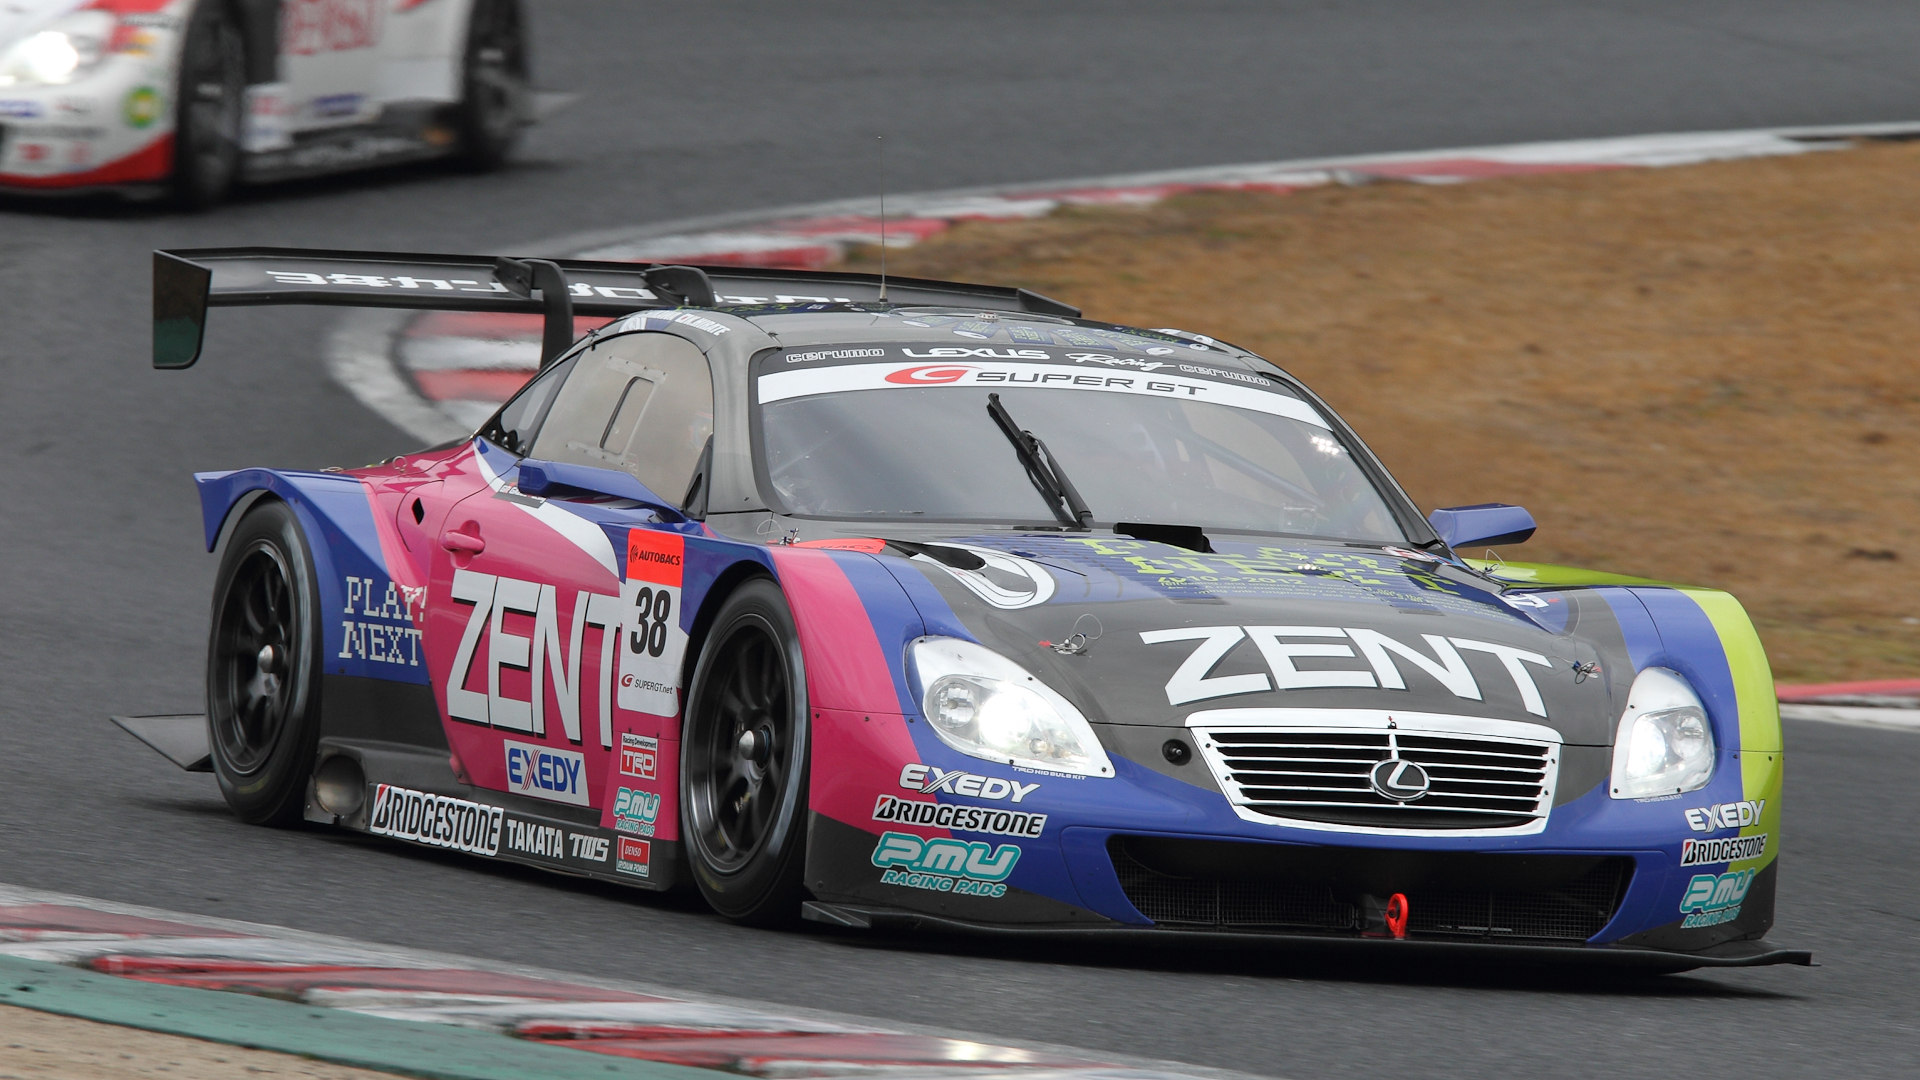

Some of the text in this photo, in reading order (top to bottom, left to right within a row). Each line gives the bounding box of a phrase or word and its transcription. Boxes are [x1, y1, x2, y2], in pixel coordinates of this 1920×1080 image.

[786, 348, 884, 363] cerumo
[902, 347, 1176, 372] LEXUS Racing
[975, 371, 1208, 396] SUPER GT
[1178, 363, 1271, 387] cerumo
[638, 550, 681, 566] AUTOBACS
[344, 576, 427, 623] PLAY!
[629, 586, 672, 658] 38
[338, 621, 423, 666] NEXT
[446, 568, 622, 752] ZENT
[1138, 625, 1555, 720] ZENT
[634, 679, 673, 695] SUPERGT.net
[622, 735, 634, 746] Racing
[508, 747, 581, 796] EXEDY
[623, 749, 655, 776] TRD
[1034, 769, 1049, 777] HID
[899, 763, 1041, 803] EXEDY
[370, 784, 504, 857] BRIDGESTONE
[615, 818, 656, 837] RACING PADS
[872, 794, 1048, 838] BRIDGESTONE
[1684, 799, 1766, 833] EXEDY
[506, 819, 610, 862] TAKATA TWS
[624, 845, 642, 858] DENSO
[1680, 833, 1768, 867] BRIDGESTONE
[633, 864, 648, 875] POWER
[881, 870, 1008, 898] RACING PADS
[1680, 911, 1723, 929] RACING
